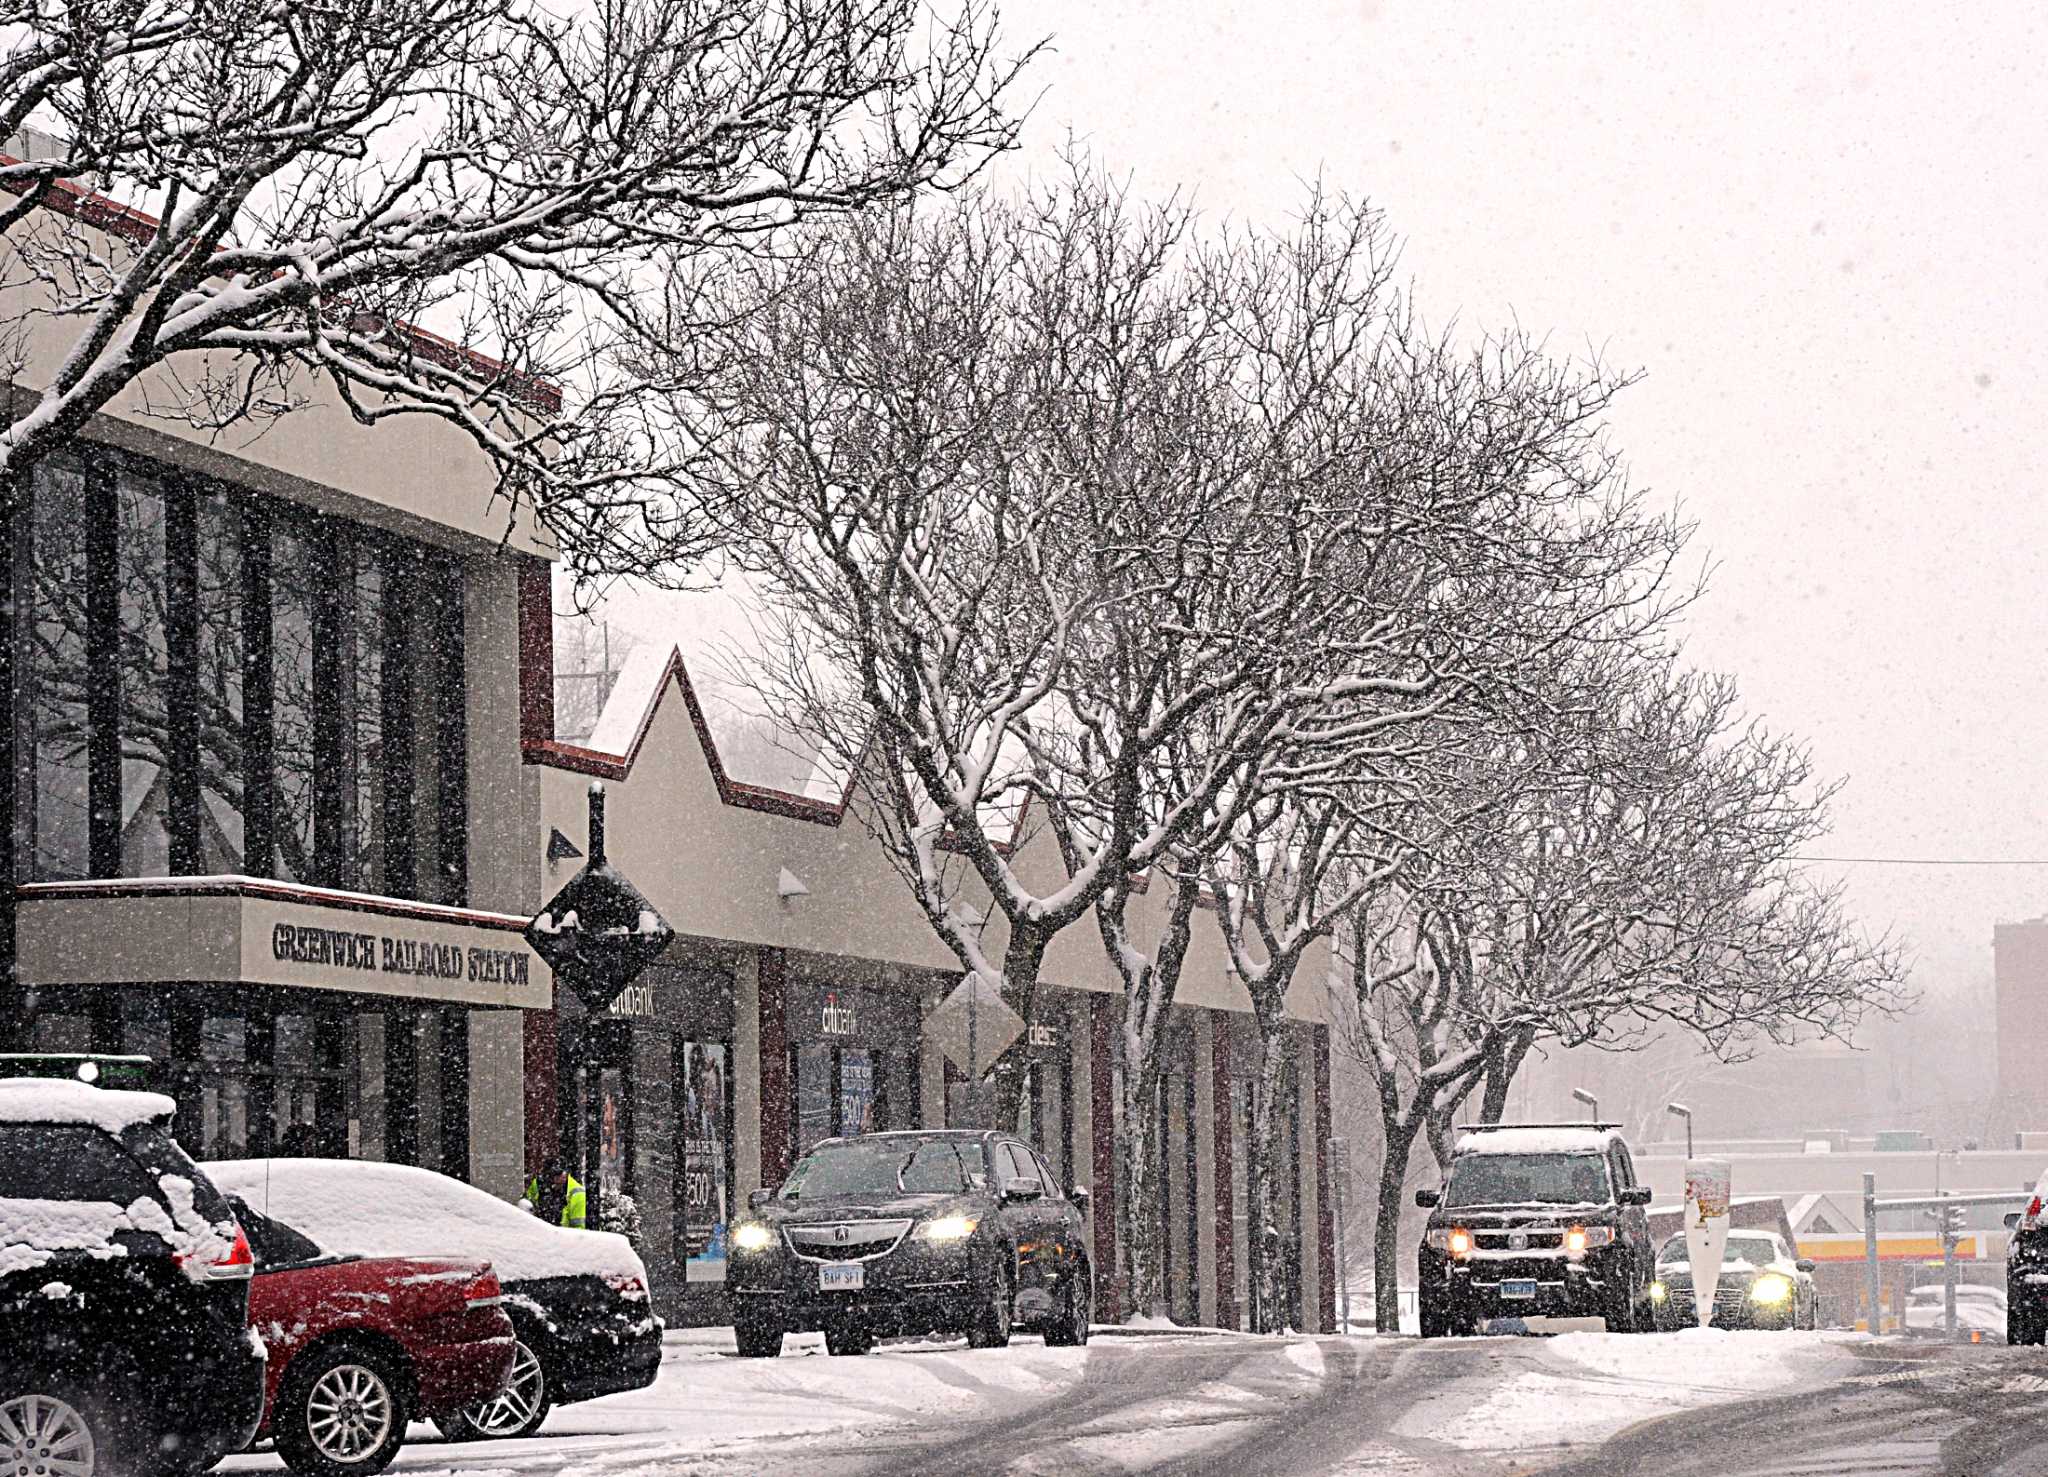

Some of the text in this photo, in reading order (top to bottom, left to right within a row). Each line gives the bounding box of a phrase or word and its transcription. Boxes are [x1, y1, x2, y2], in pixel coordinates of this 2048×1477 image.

[272, 923, 529, 985] GREENWICH RAILROAD STATION
